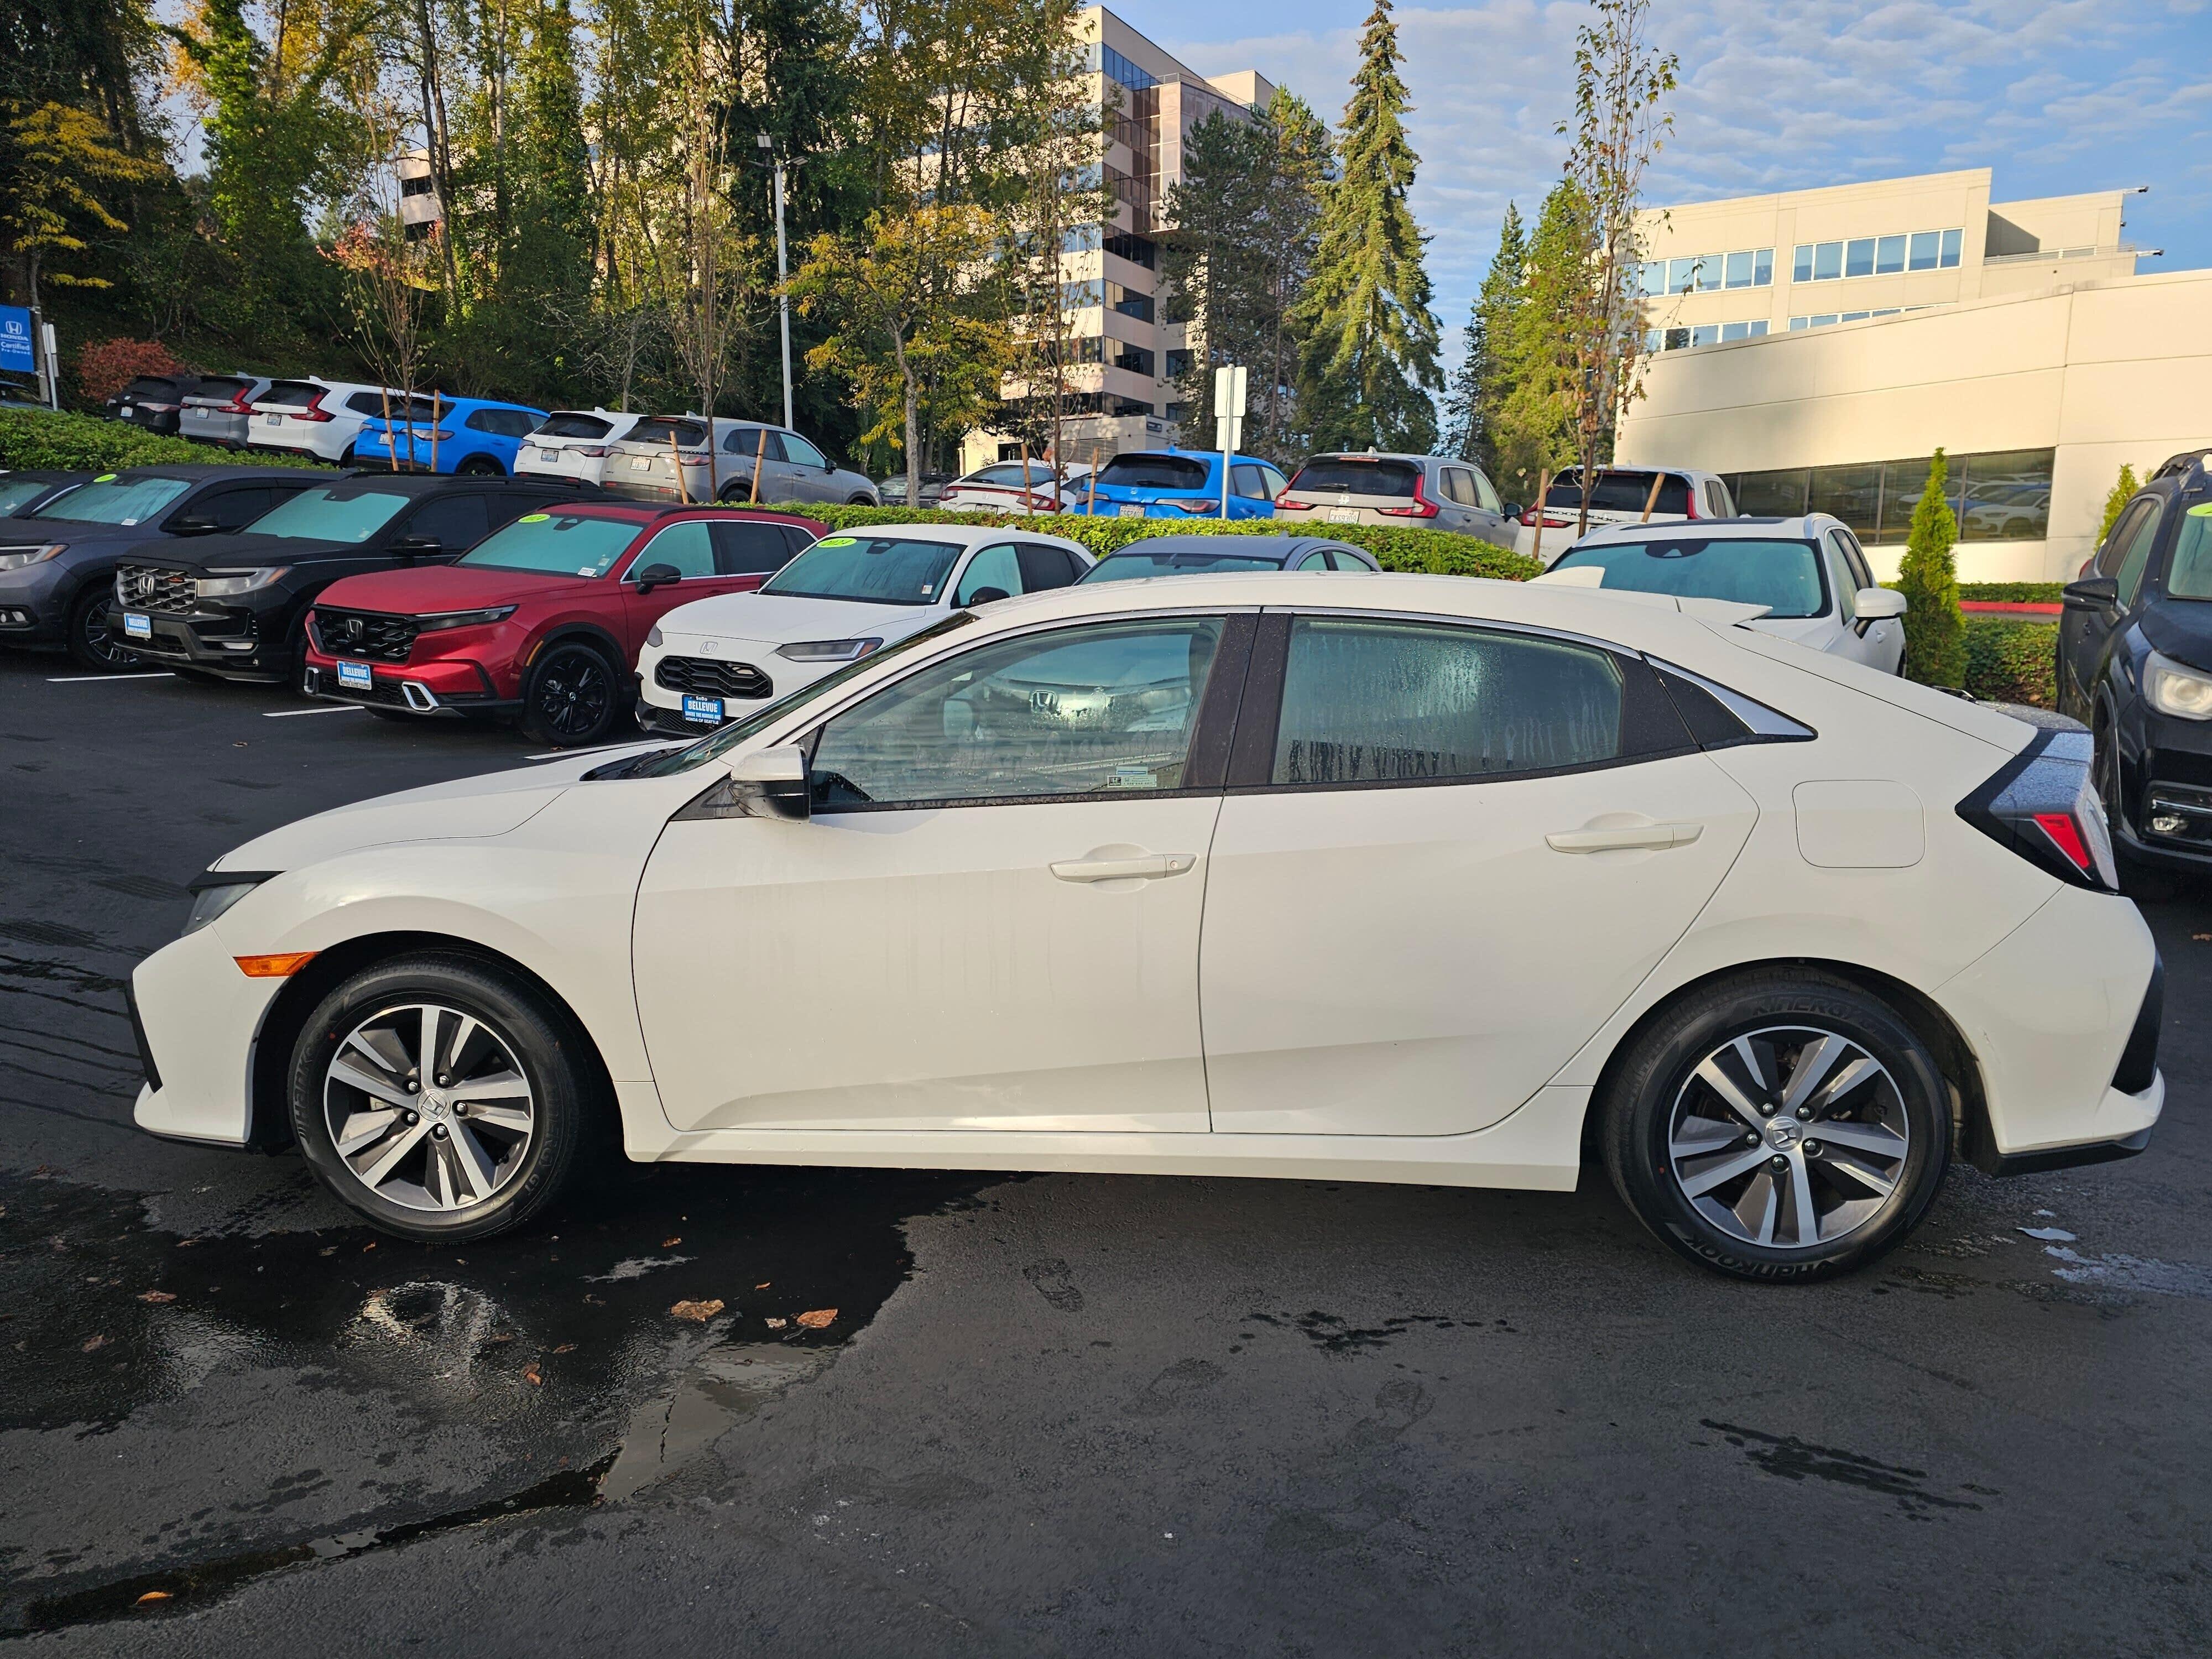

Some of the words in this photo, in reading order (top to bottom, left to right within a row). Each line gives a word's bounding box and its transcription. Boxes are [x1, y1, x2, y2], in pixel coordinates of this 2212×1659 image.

[1, 341, 30, 351] Certified
[342, 666, 368, 679] BELLEVUE
[688, 701, 717, 713] BELLEVUE
